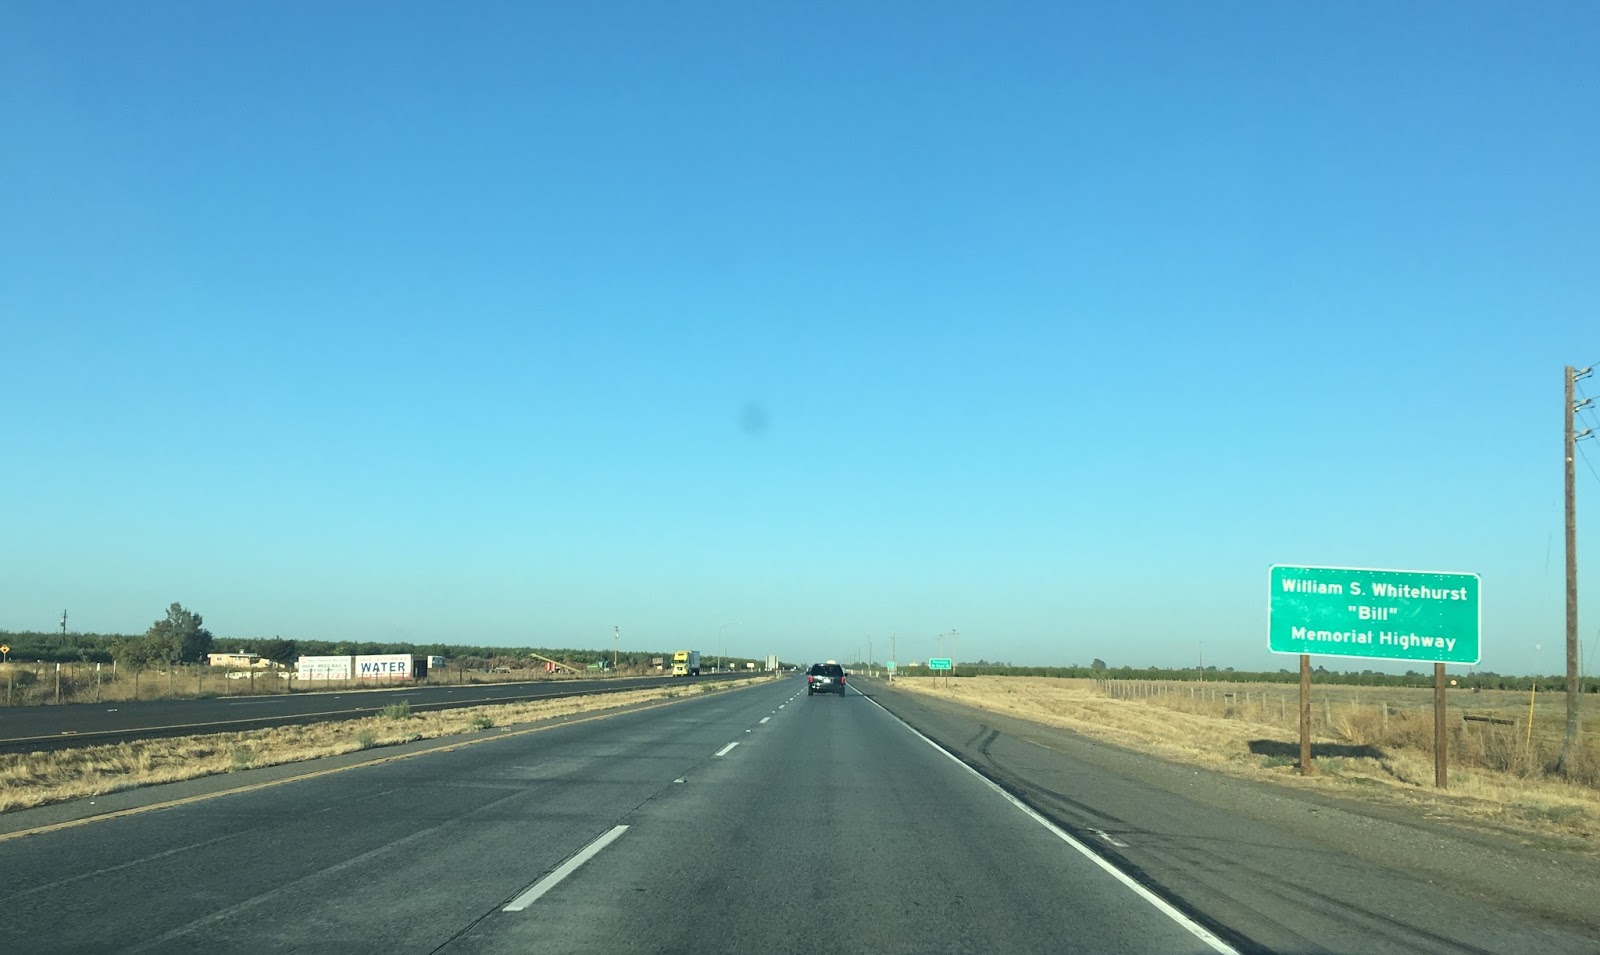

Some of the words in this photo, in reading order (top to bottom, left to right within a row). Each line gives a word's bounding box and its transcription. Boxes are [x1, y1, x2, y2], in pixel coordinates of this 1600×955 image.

[1281, 579, 1343, 595] William
[1349, 582, 1366, 596] S.
[1372, 583, 1467, 601] Whitehurst
[1348, 606, 1398, 621] "Bill"
[1291, 626, 1372, 644] Memorial
[1379, 631, 1456, 652] Highway
[361, 661, 406, 672] WATER
